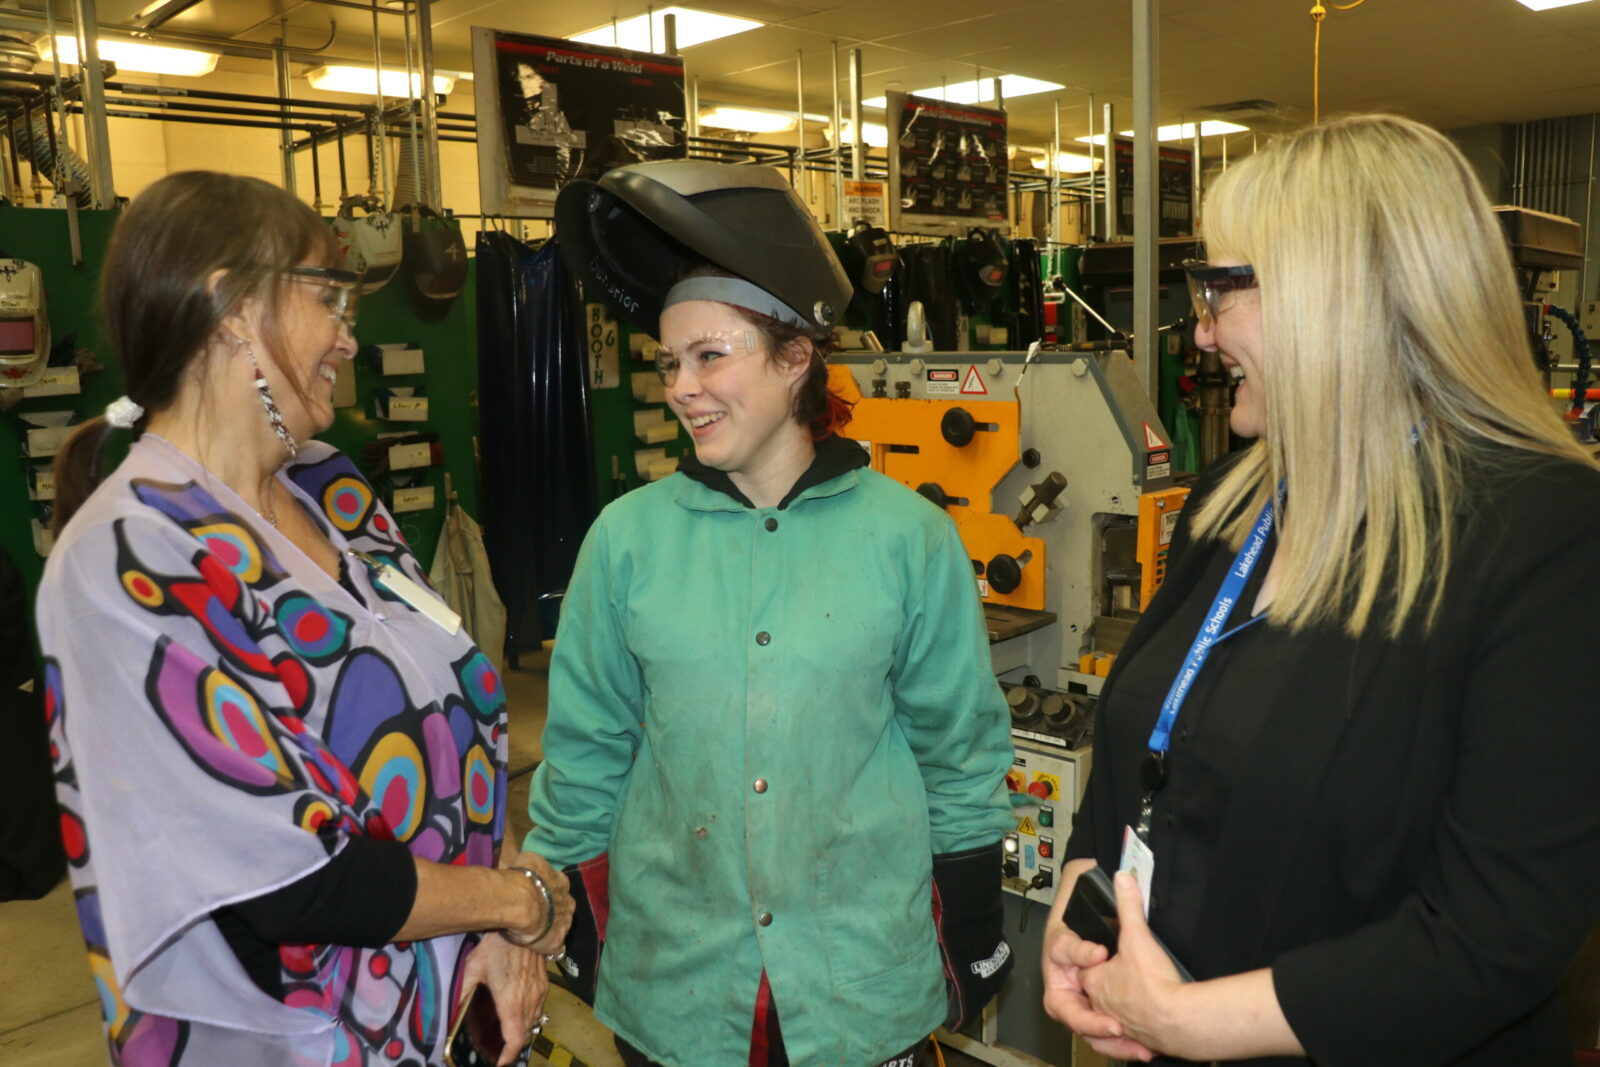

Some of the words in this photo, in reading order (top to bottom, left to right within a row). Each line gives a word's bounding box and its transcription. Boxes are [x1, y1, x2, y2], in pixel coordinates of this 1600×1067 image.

[546, 51, 582, 66] Parts
[585, 58, 598, 69] of
[601, 61, 609, 69] a
[612, 60, 643, 74] Weld
[589, 258, 639, 313] Suerior
[590, 307, 604, 385] BOOTH
[1151, 454, 1167, 462] DANGER
[1235, 535, 1264, 578] Lakehead
[1205, 597, 1233, 635] Schools
[883, 1053, 914, 1067] RTS
